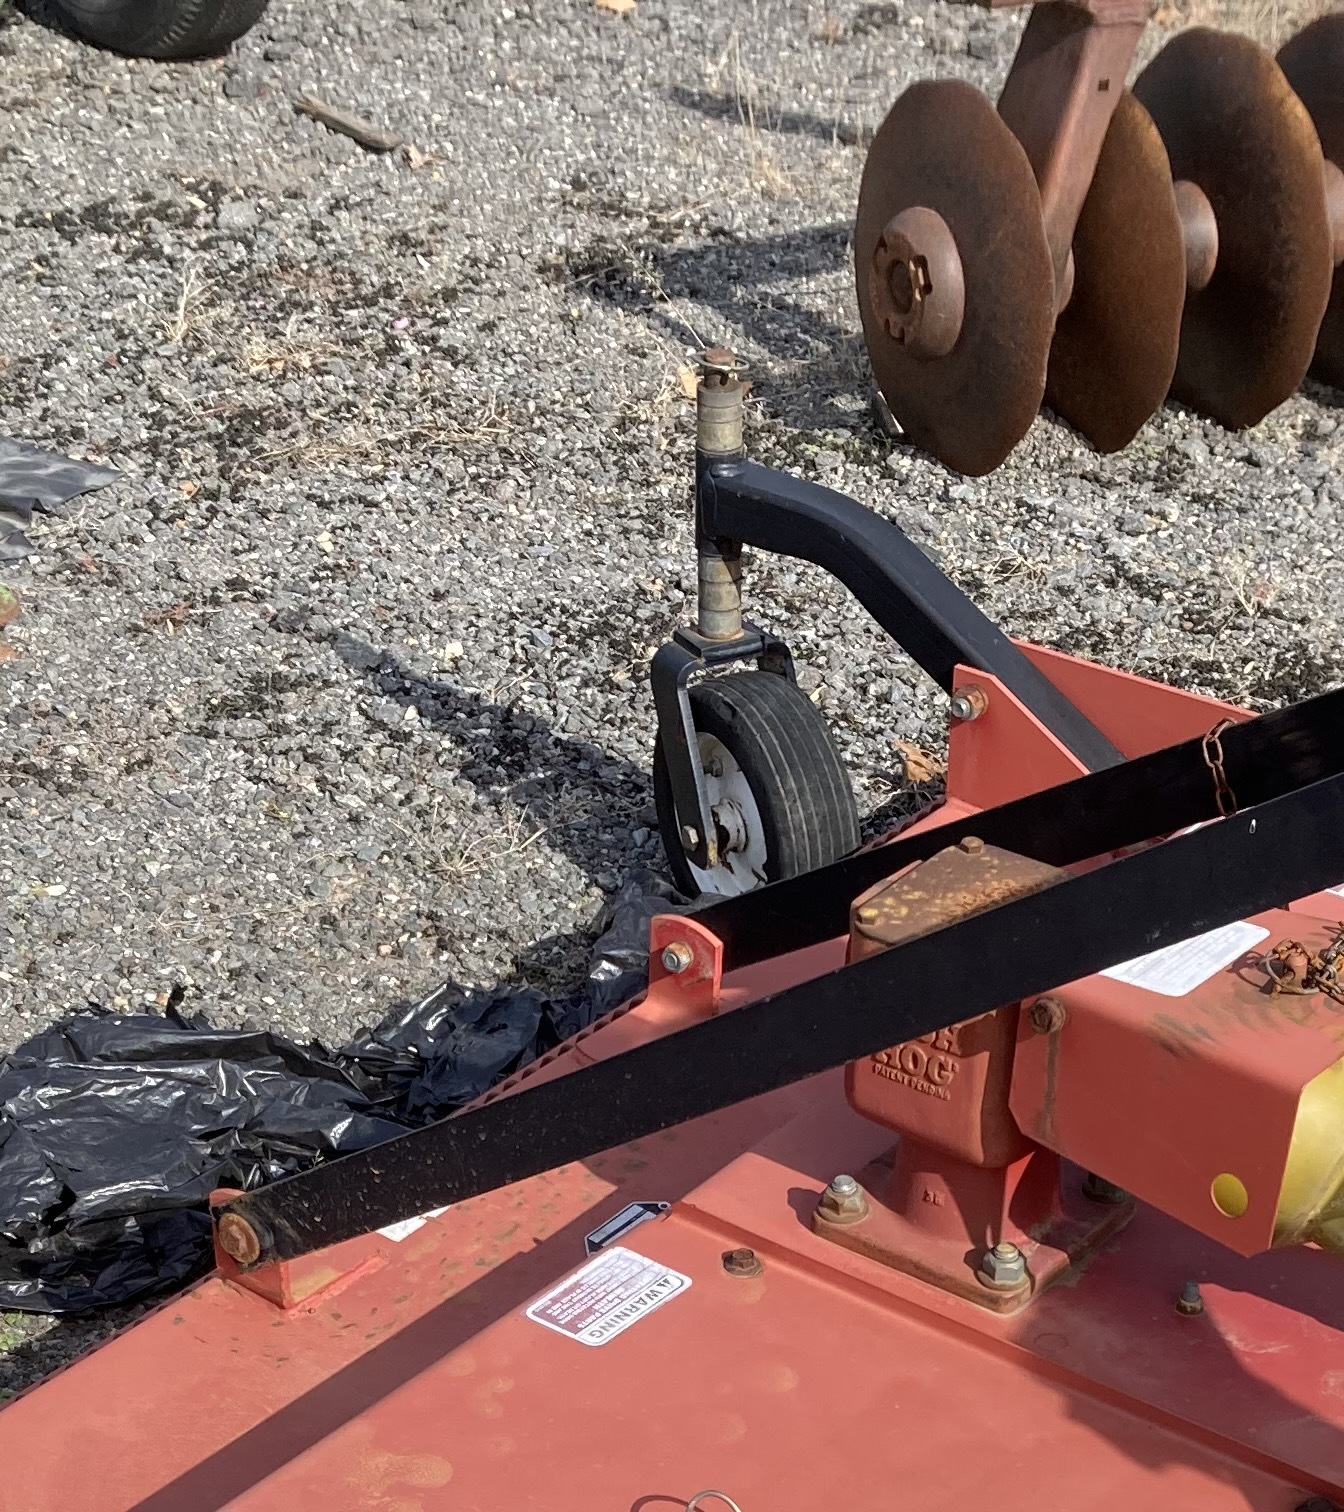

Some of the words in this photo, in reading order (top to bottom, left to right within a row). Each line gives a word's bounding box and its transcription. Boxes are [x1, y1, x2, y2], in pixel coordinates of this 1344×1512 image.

[872, 1063, 909, 1086] PATENT
[908, 1076, 952, 1101] PENDING
[588, 1288, 664, 1338] WARNING
